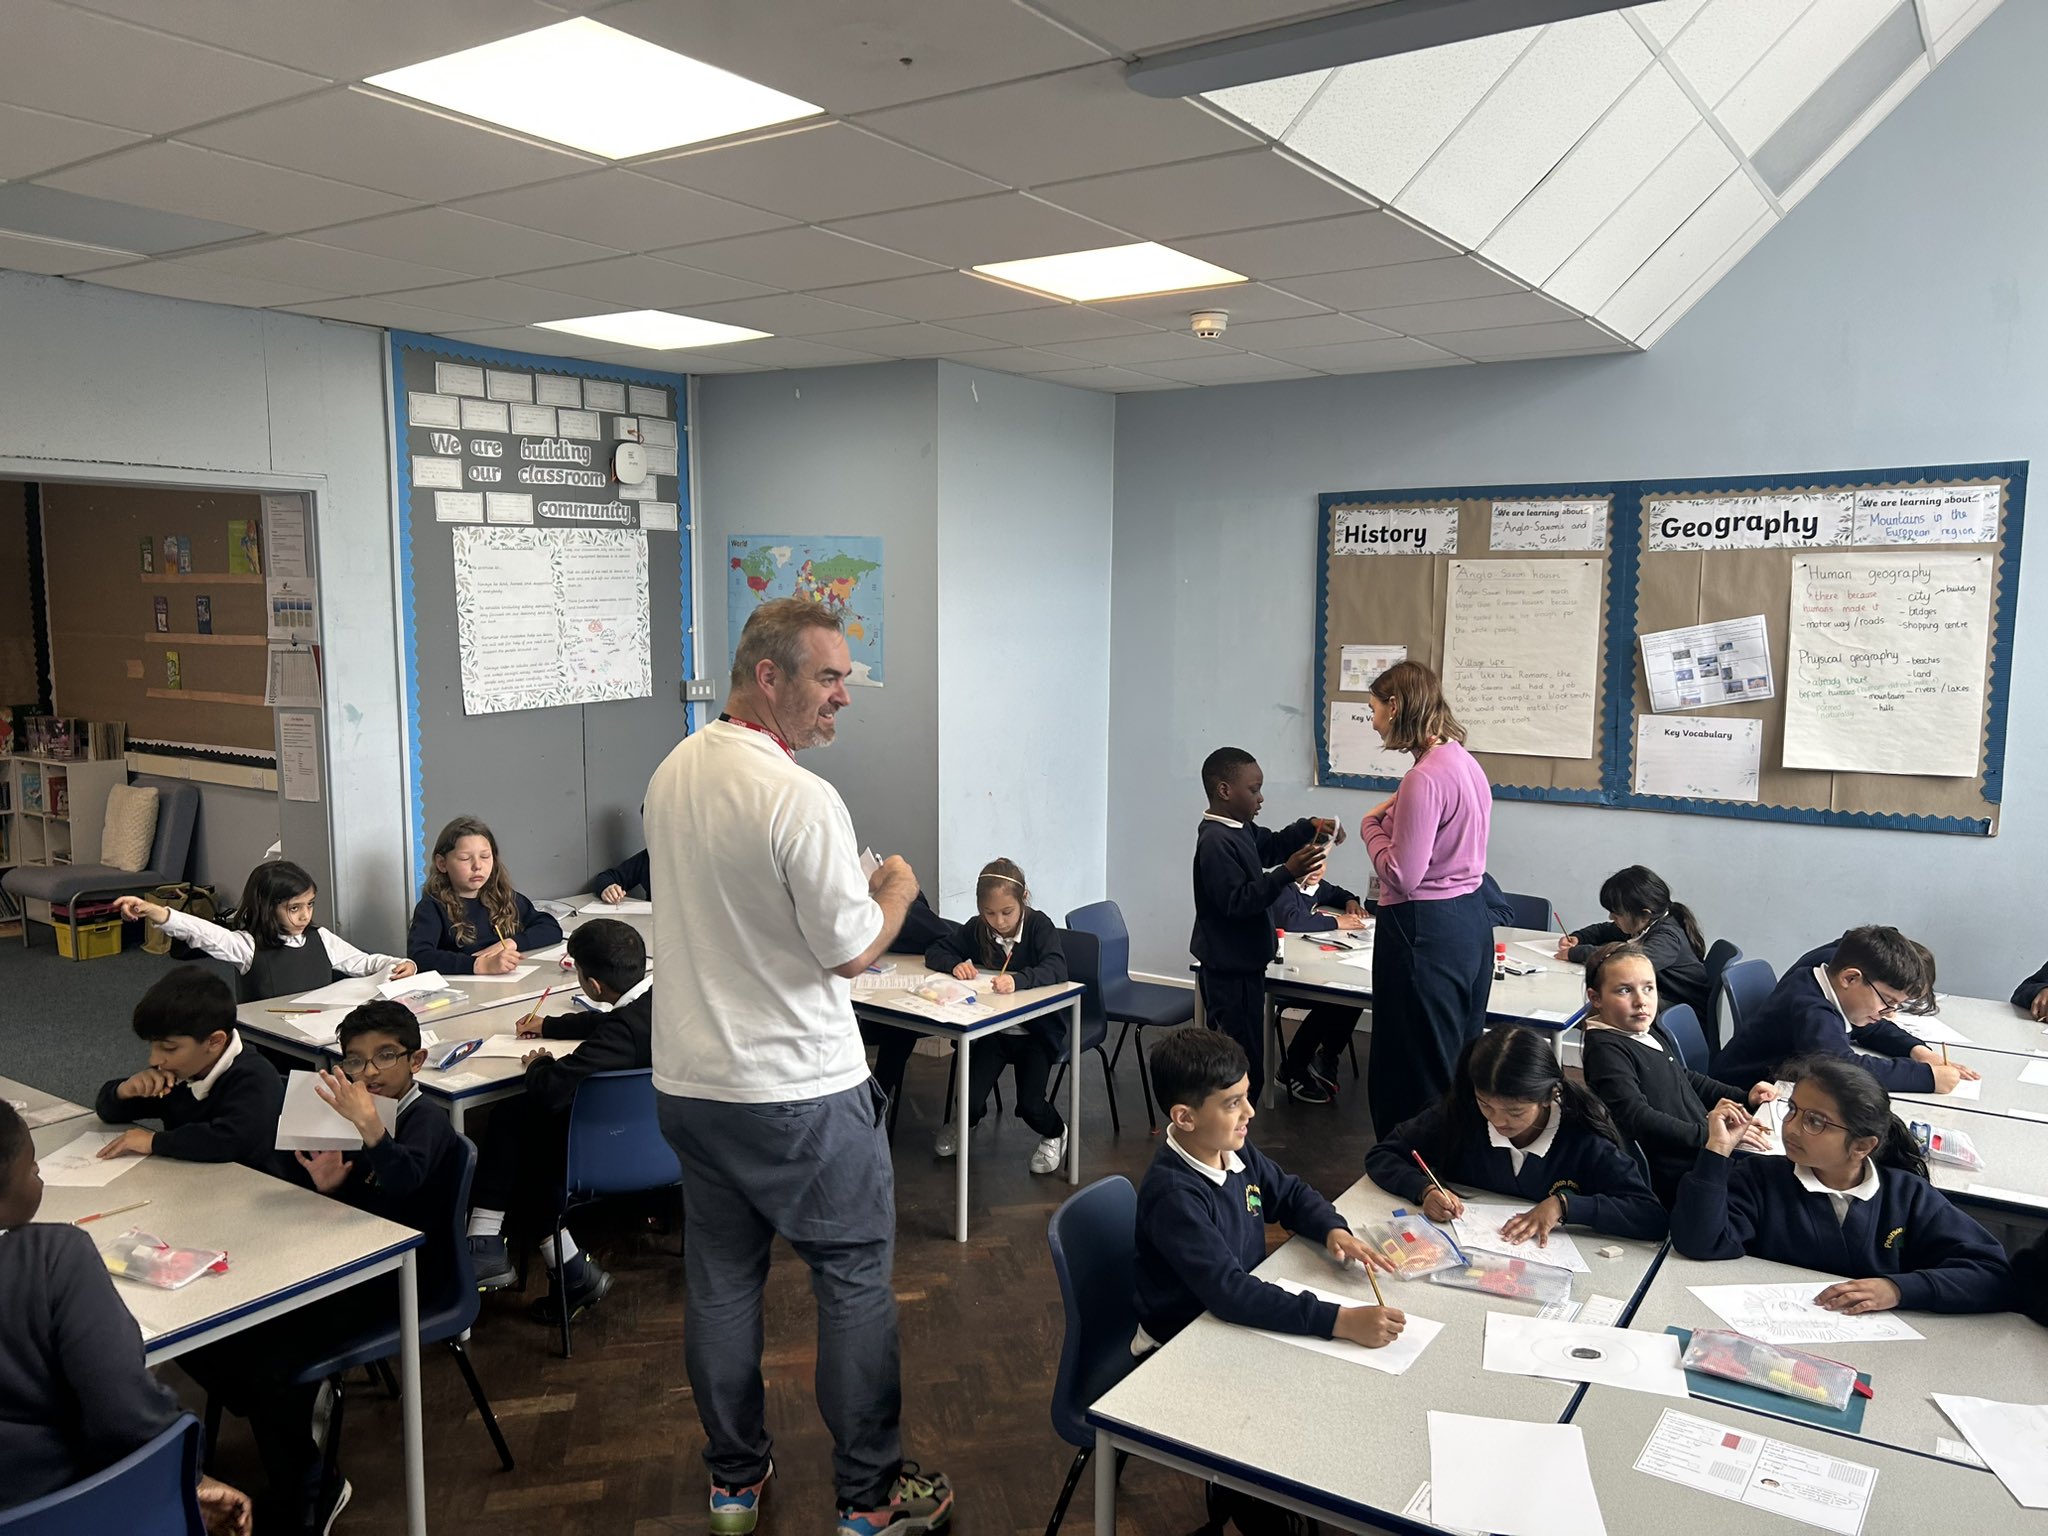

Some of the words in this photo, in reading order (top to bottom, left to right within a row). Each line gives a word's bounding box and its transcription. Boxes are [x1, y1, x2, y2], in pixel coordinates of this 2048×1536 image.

[432, 433, 460, 453] We
[471, 441, 501, 456] are
[521, 439, 591, 465] building
[468, 466, 501, 480] our
[518, 466, 605, 487] classroom
[1862, 499, 1878, 507] We
[1900, 497, 1942, 507] learning
[1526, 509, 1560, 518] learning
[1870, 513, 1925, 527] Mountains
[1934, 514, 1942, 522] in
[1951, 508, 1968, 519] the
[1571, 520, 1587, 530] and
[1660, 511, 1819, 540] Geography
[1344, 523, 1427, 549] History
[1540, 534, 1567, 544] Scots
[1886, 528, 1930, 539] European
[1941, 527, 1975, 540] region
[730, 540, 748, 548] World
[1532, 568, 1561, 579] houses
[1808, 564, 1852, 580] Human
[1868, 563, 1932, 585] geography
[1814, 591, 1838, 601] there
[1847, 590, 1878, 600] because
[1908, 591, 1931, 605] city
[1803, 604, 1833, 613] humans
[1842, 604, 1866, 613] made
[1454, 657, 1484, 670] Village
[1489, 658, 1505, 668] life
[1798, 649, 1843, 670] Physical
[1849, 649, 1899, 667] geography
[1556, 670, 1571, 678] the
[1913, 670, 1932, 678] land
[1555, 704, 1569, 712] for
[1351, 714, 1364, 723] Key
[1664, 728, 1680, 738] Key
[1682, 729, 1733, 741] Vocabulary
